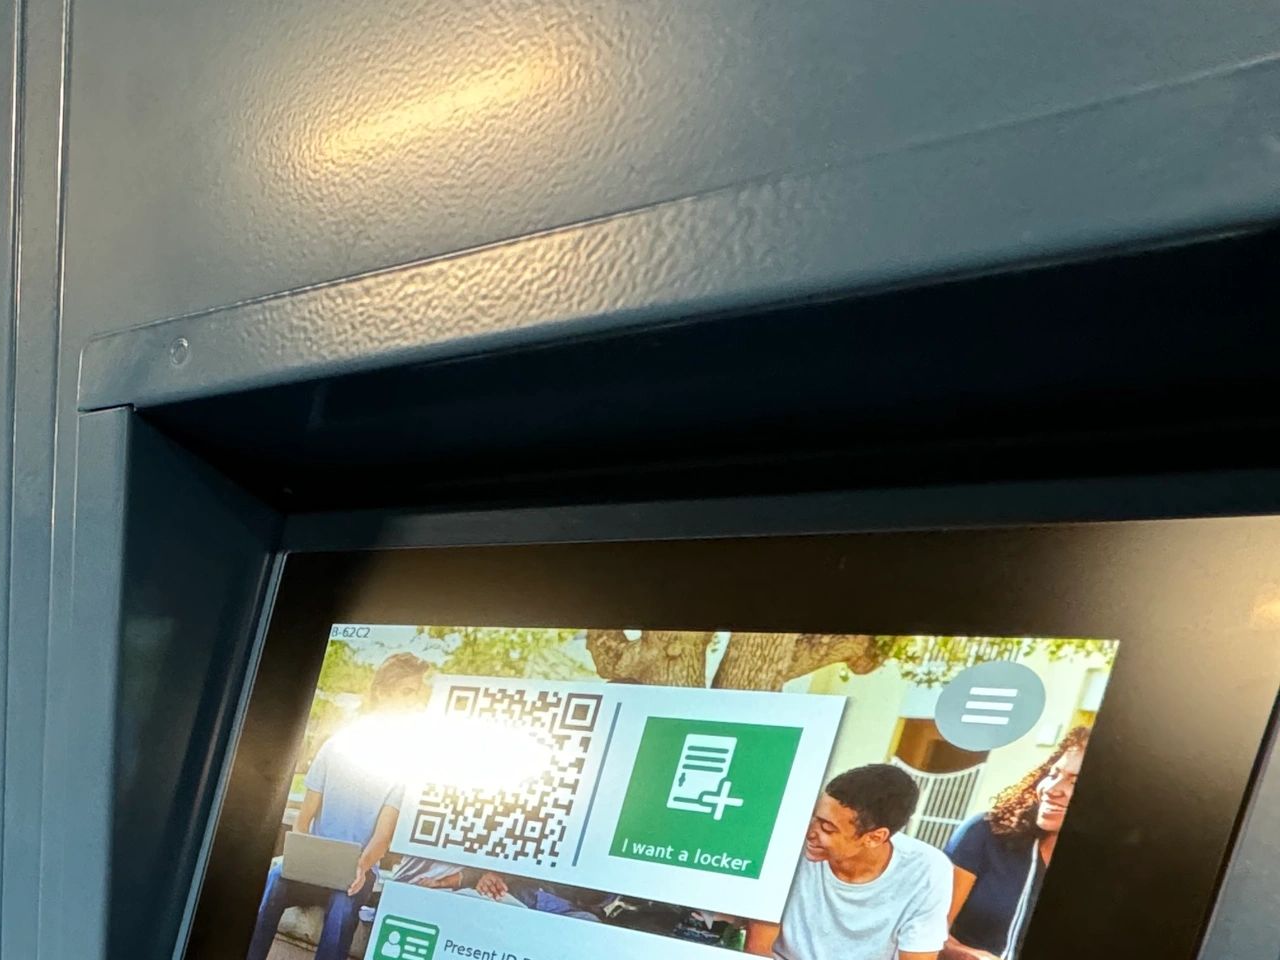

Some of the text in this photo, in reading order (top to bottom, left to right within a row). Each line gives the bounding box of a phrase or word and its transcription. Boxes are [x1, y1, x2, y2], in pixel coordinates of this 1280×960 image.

[622, 838, 752, 872] I want a locker
